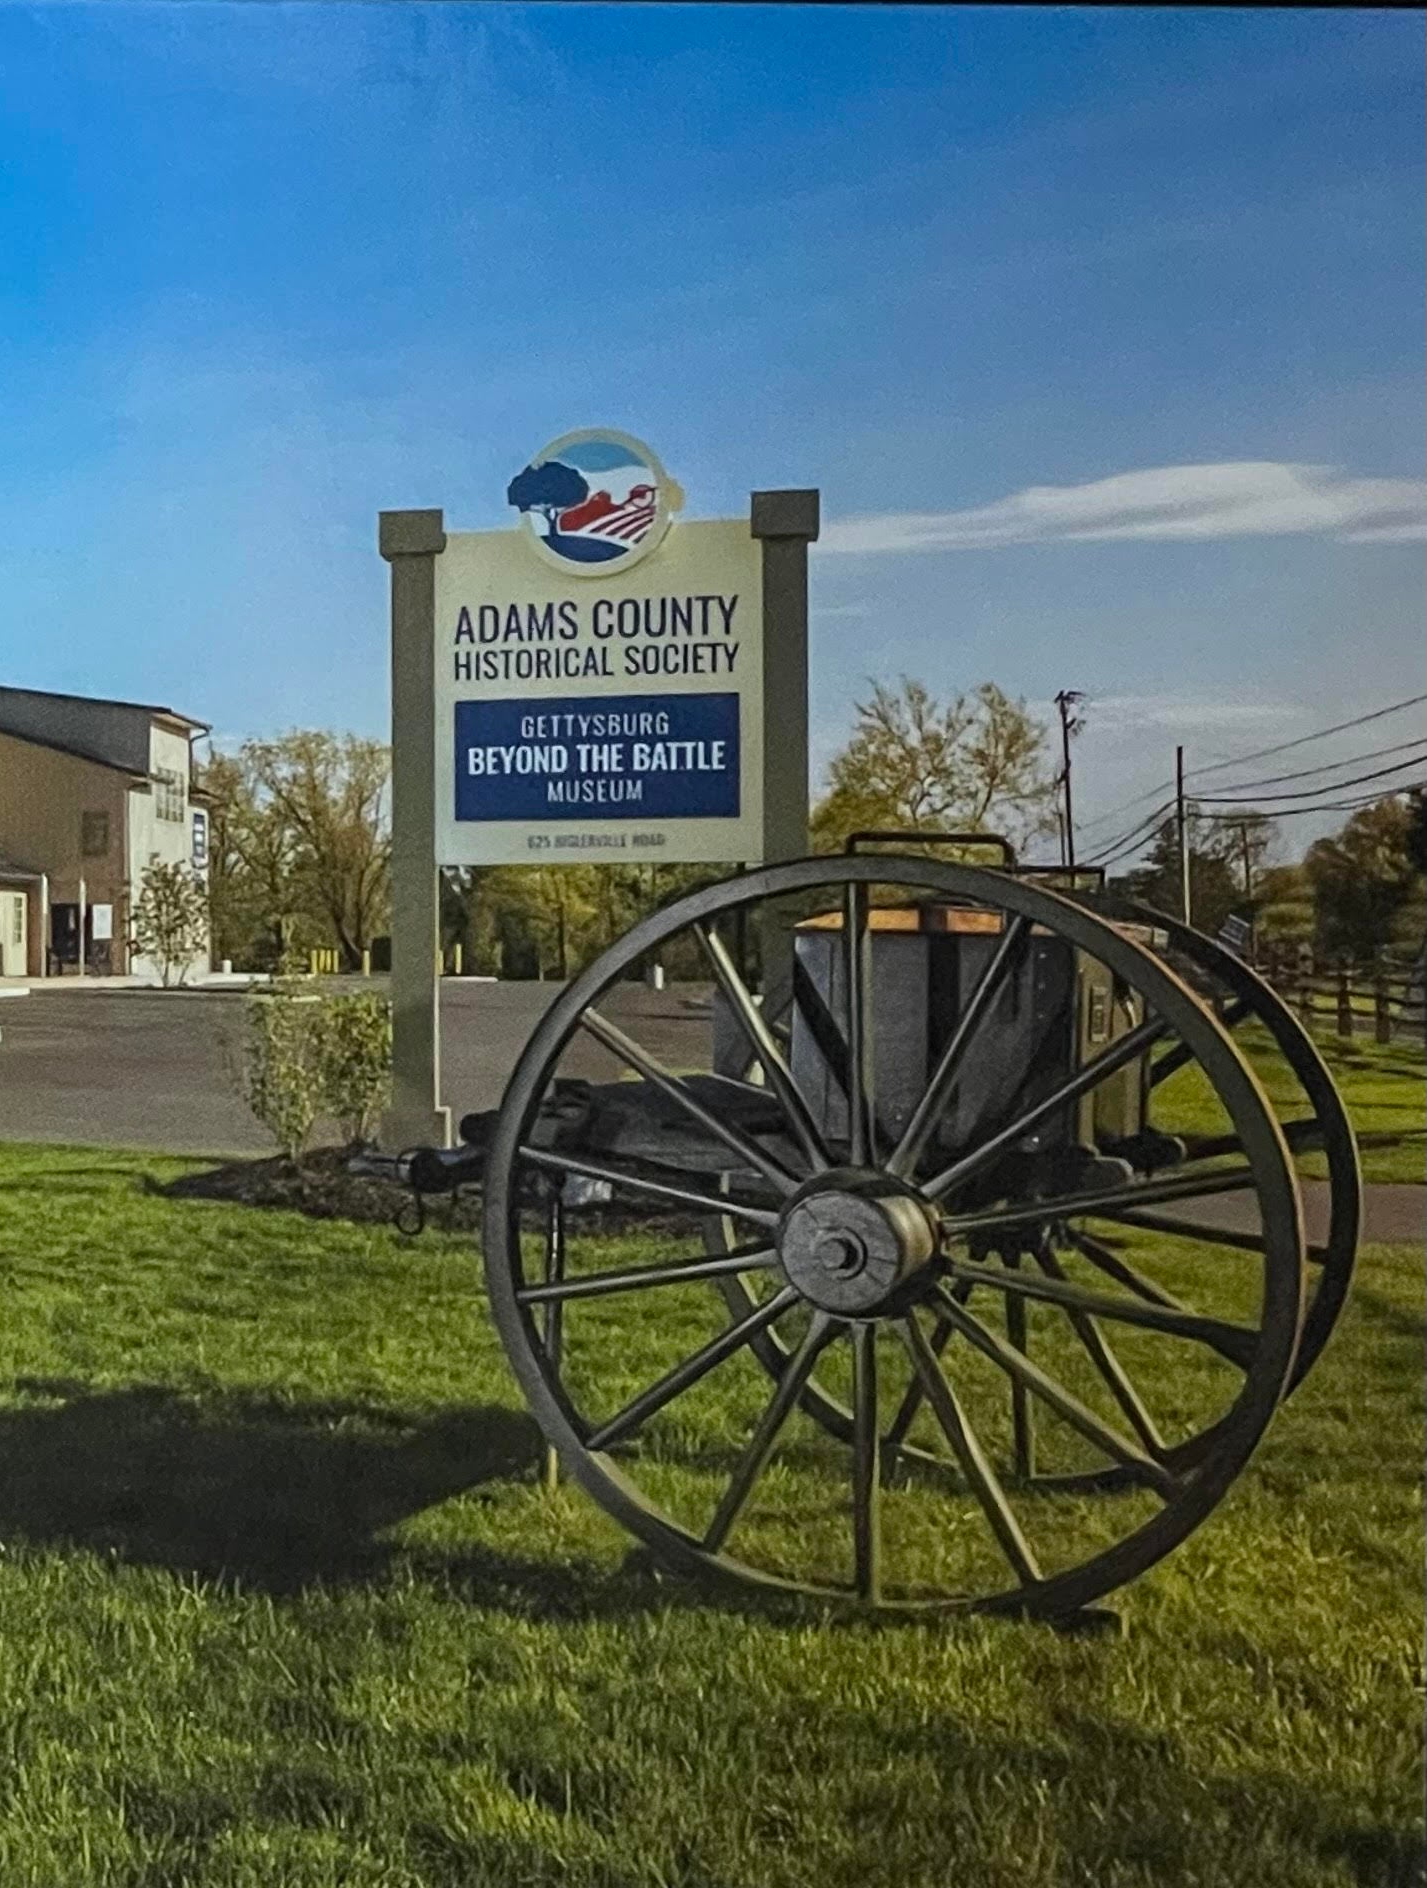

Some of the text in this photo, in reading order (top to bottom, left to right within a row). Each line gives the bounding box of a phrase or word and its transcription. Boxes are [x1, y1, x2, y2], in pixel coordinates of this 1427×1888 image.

[454, 594, 739, 645] ADAMS COUNTY
[454, 642, 740, 681] HISTORICAL SOCIETY
[521, 711, 670, 739] GETTYSBURG
[467, 740, 726, 775] BEYOND THE BATTLE
[546, 779, 644, 803] MUSEUM
